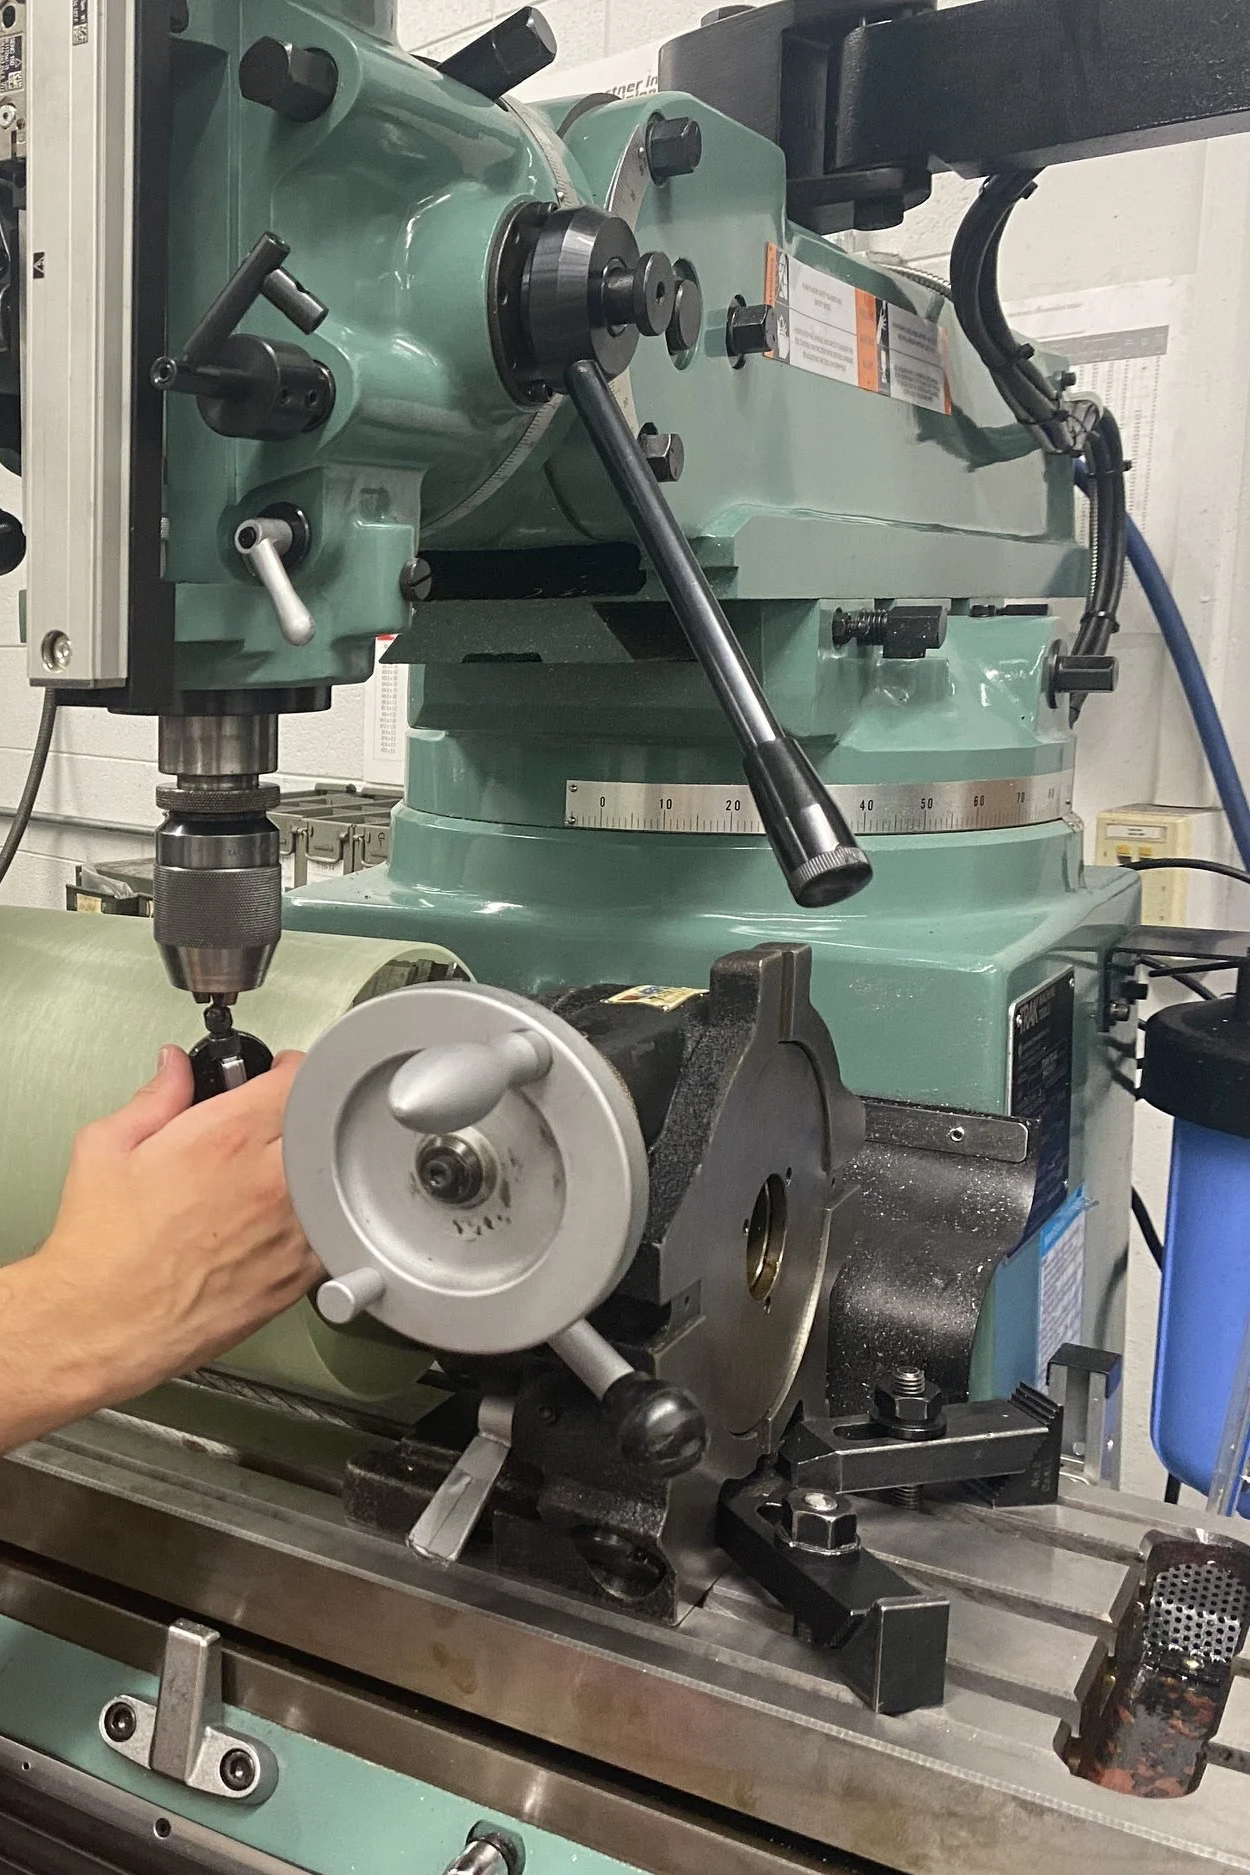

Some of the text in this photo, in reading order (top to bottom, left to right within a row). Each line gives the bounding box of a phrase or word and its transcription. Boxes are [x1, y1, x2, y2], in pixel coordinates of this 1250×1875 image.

[605, 80, 643, 95] tner
[600, 796, 606, 808] 0
[659, 798, 673, 810] 10
[725, 799, 741, 811] 20
[859, 799, 874, 811] 40
[920, 797, 934, 810] 50
[973, 794, 985, 807] 60
